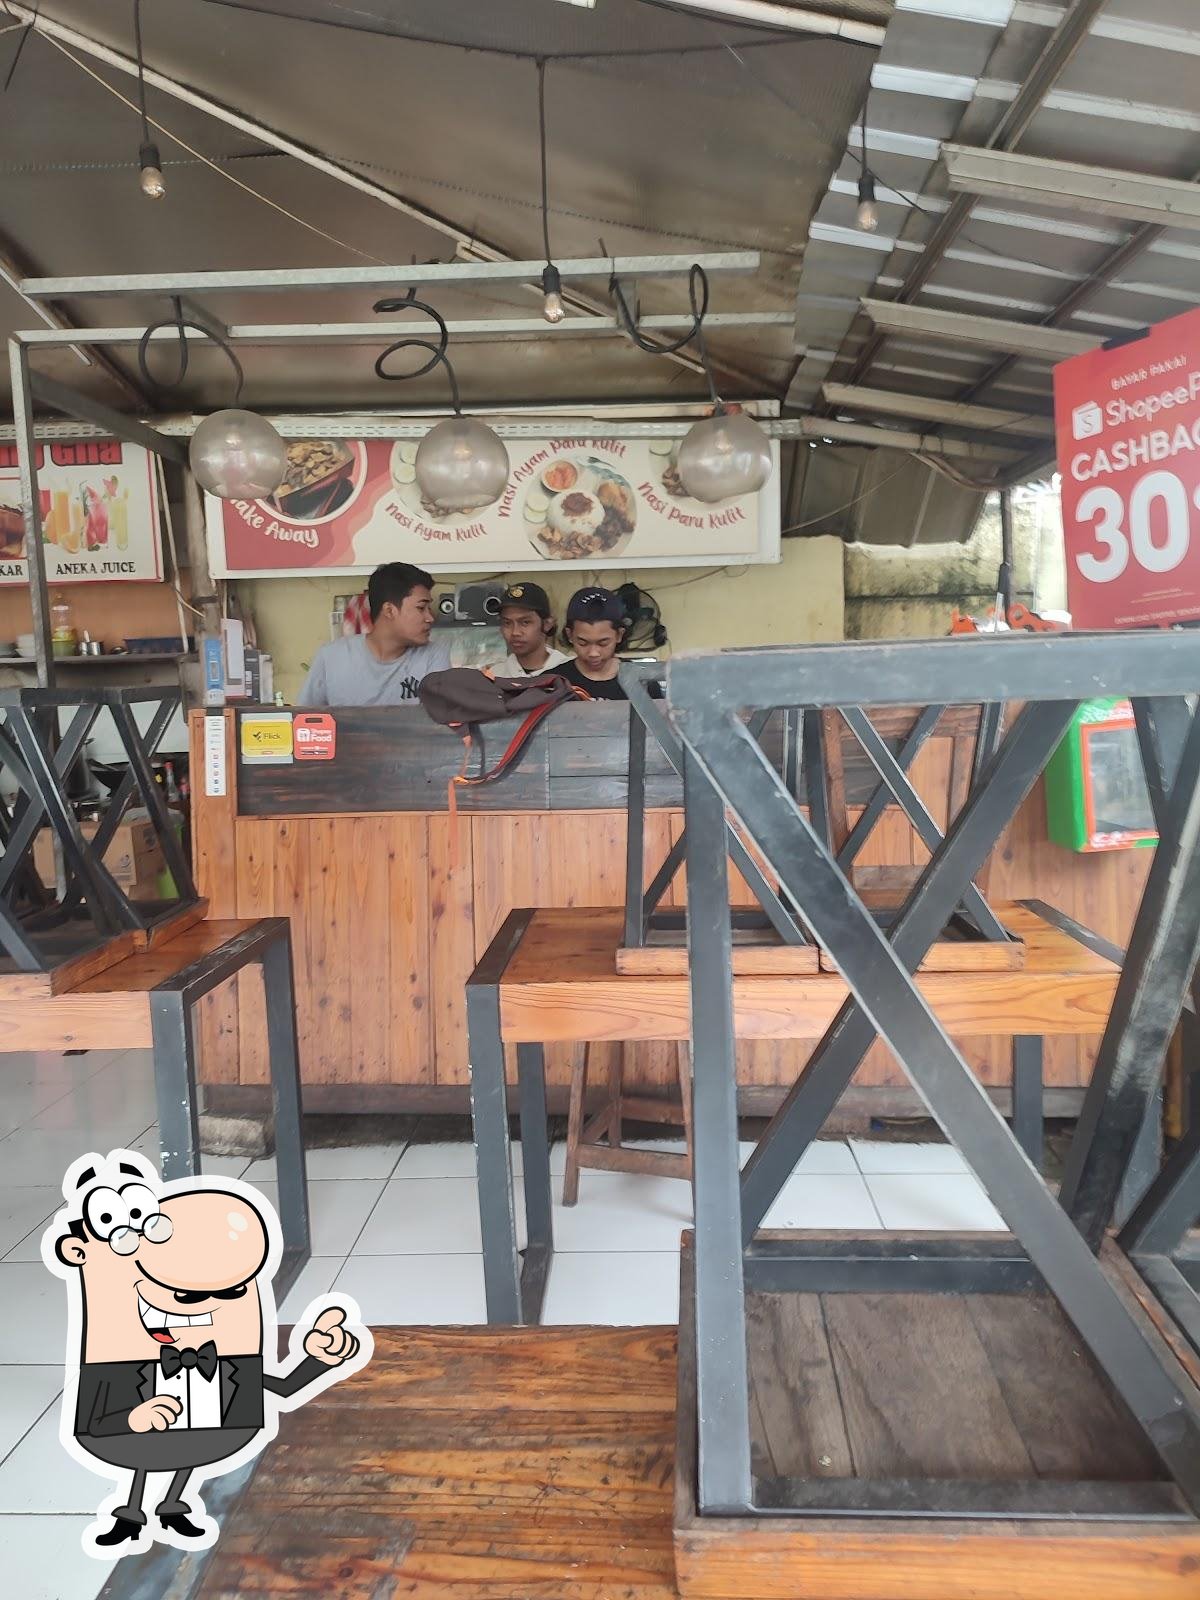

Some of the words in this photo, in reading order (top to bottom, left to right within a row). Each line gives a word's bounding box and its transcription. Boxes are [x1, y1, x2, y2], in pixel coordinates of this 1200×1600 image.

[513, 449, 549, 482] Ayam
[264, 521, 320, 548] Away
[413, 522, 452, 541] Ayam
[56, 563, 97, 575] ANEKA
[101, 562, 136, 574] JUICE
